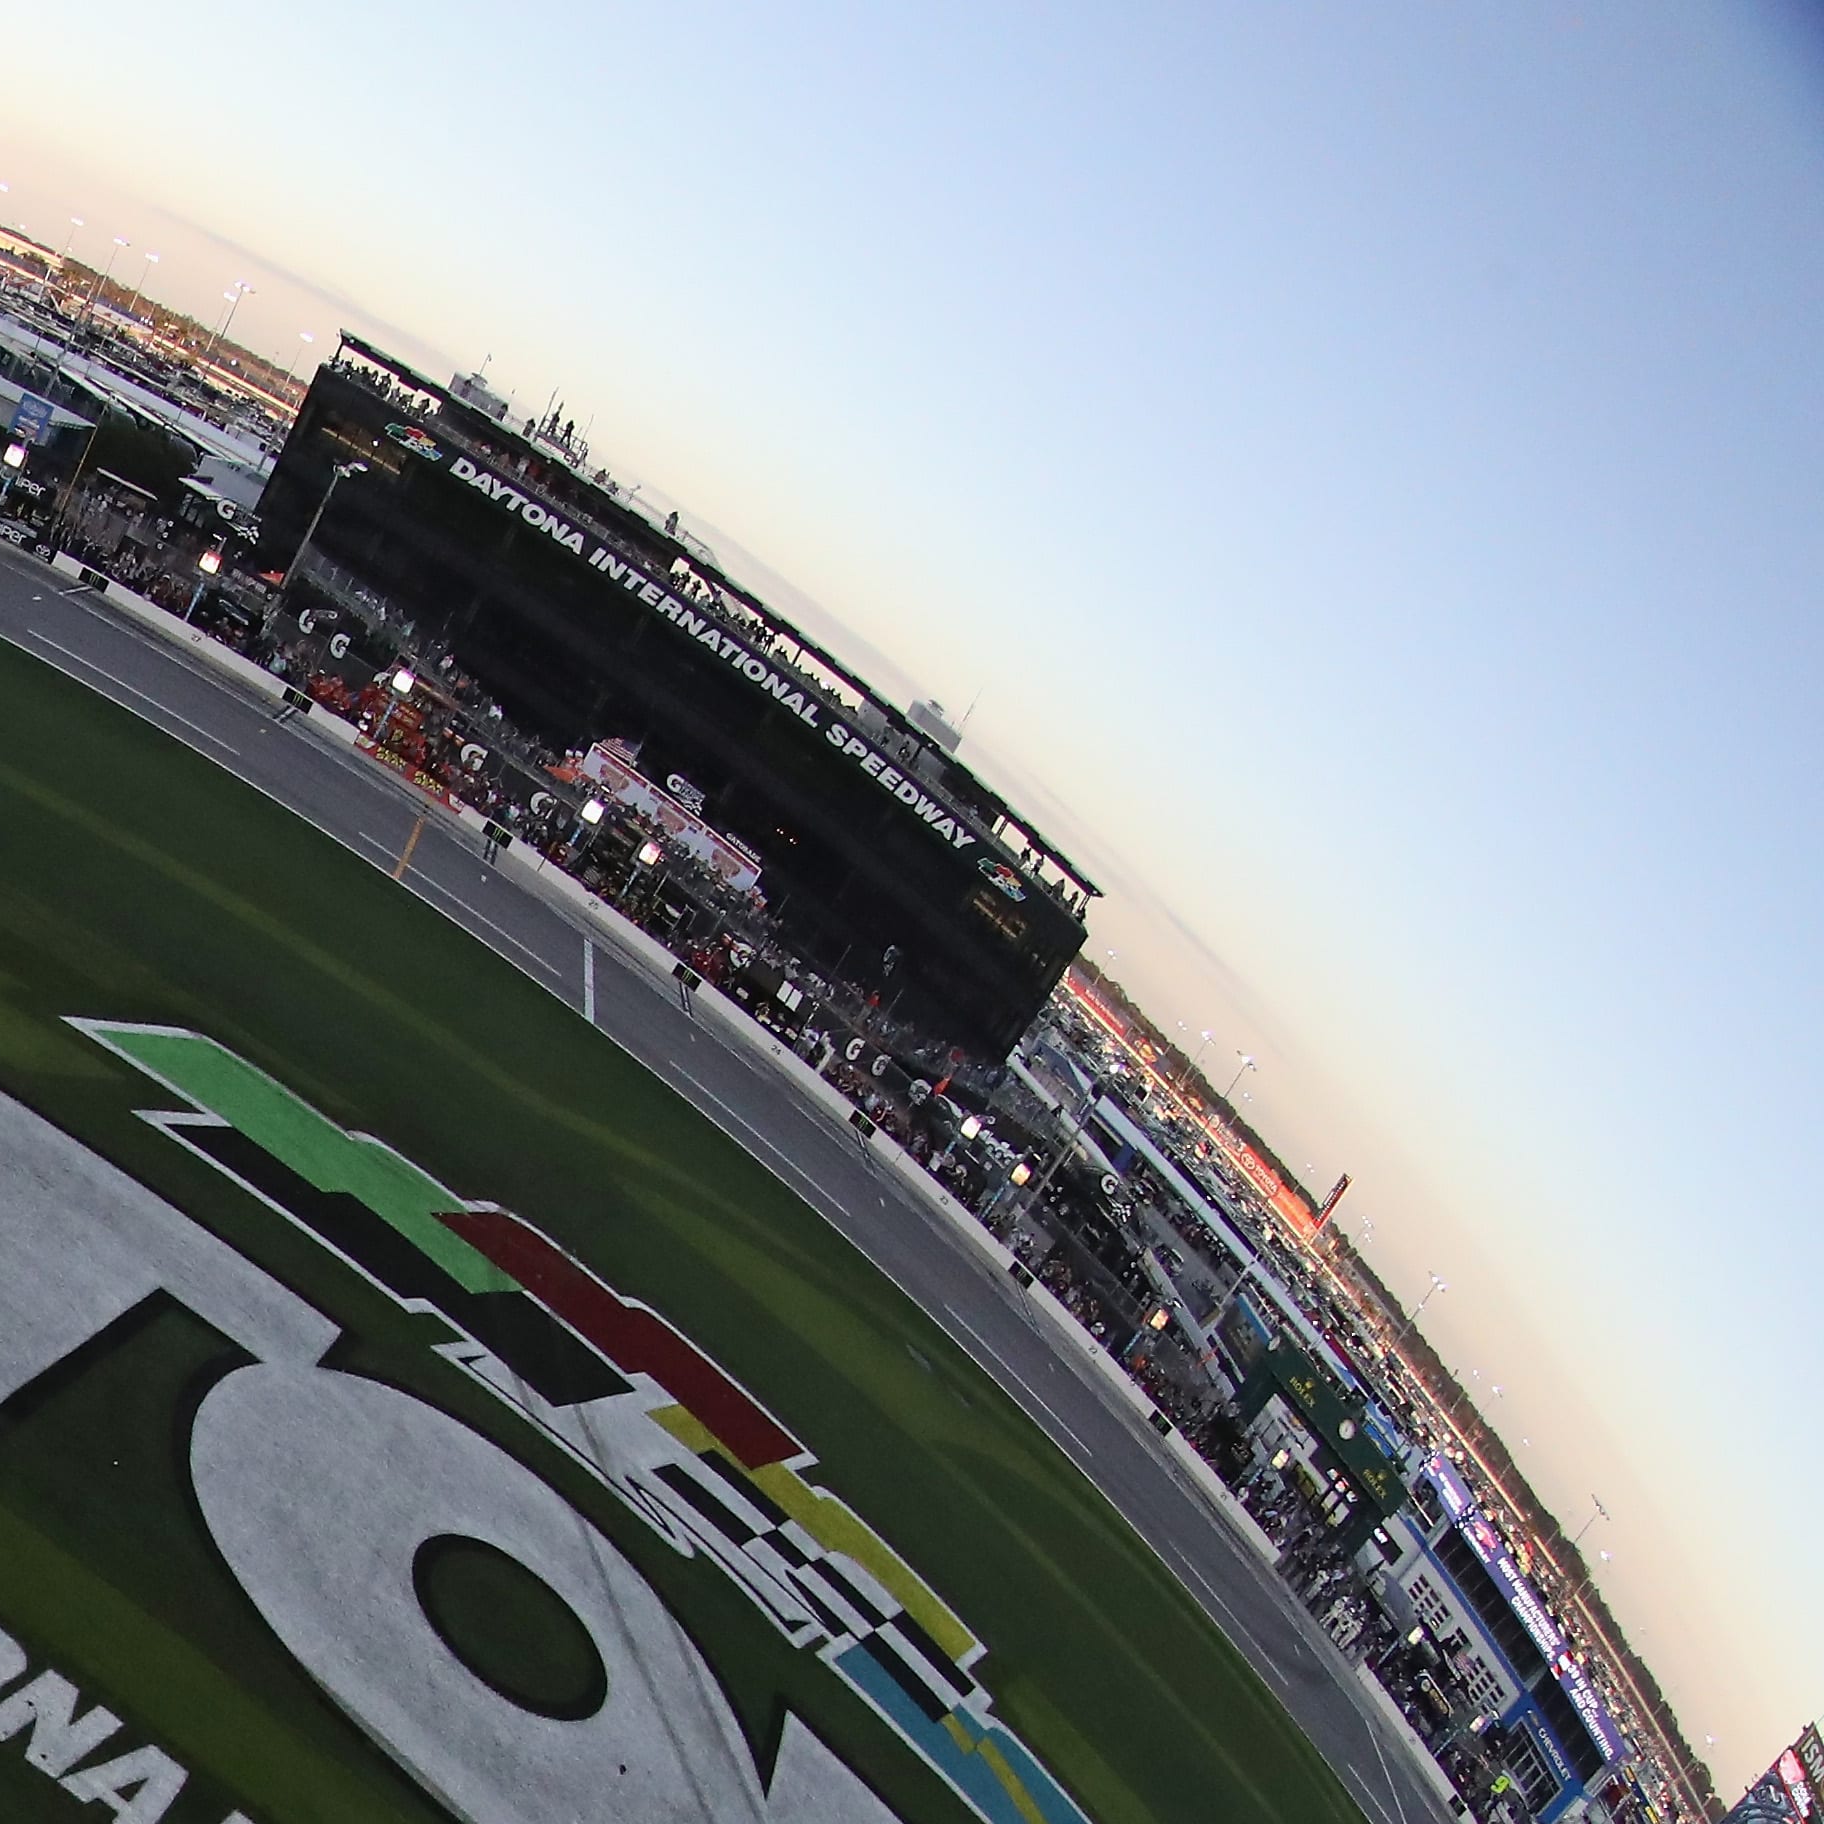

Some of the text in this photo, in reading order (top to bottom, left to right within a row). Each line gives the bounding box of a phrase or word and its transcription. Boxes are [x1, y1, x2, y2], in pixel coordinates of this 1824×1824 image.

[449, 457, 976, 851] DAYTONA INTERNATIONAL SPEEDWAY
[726, 833, 762, 864] GATORADE
[1254, 1164, 1278, 1193] TOYOTA
[1289, 1375, 1316, 1408] ROLEX
[1362, 1468, 1387, 1499] ROLEX
[1497, 1557, 1515, 1584] MOST
[1538, 1726, 1573, 1782] CHEVROLET
